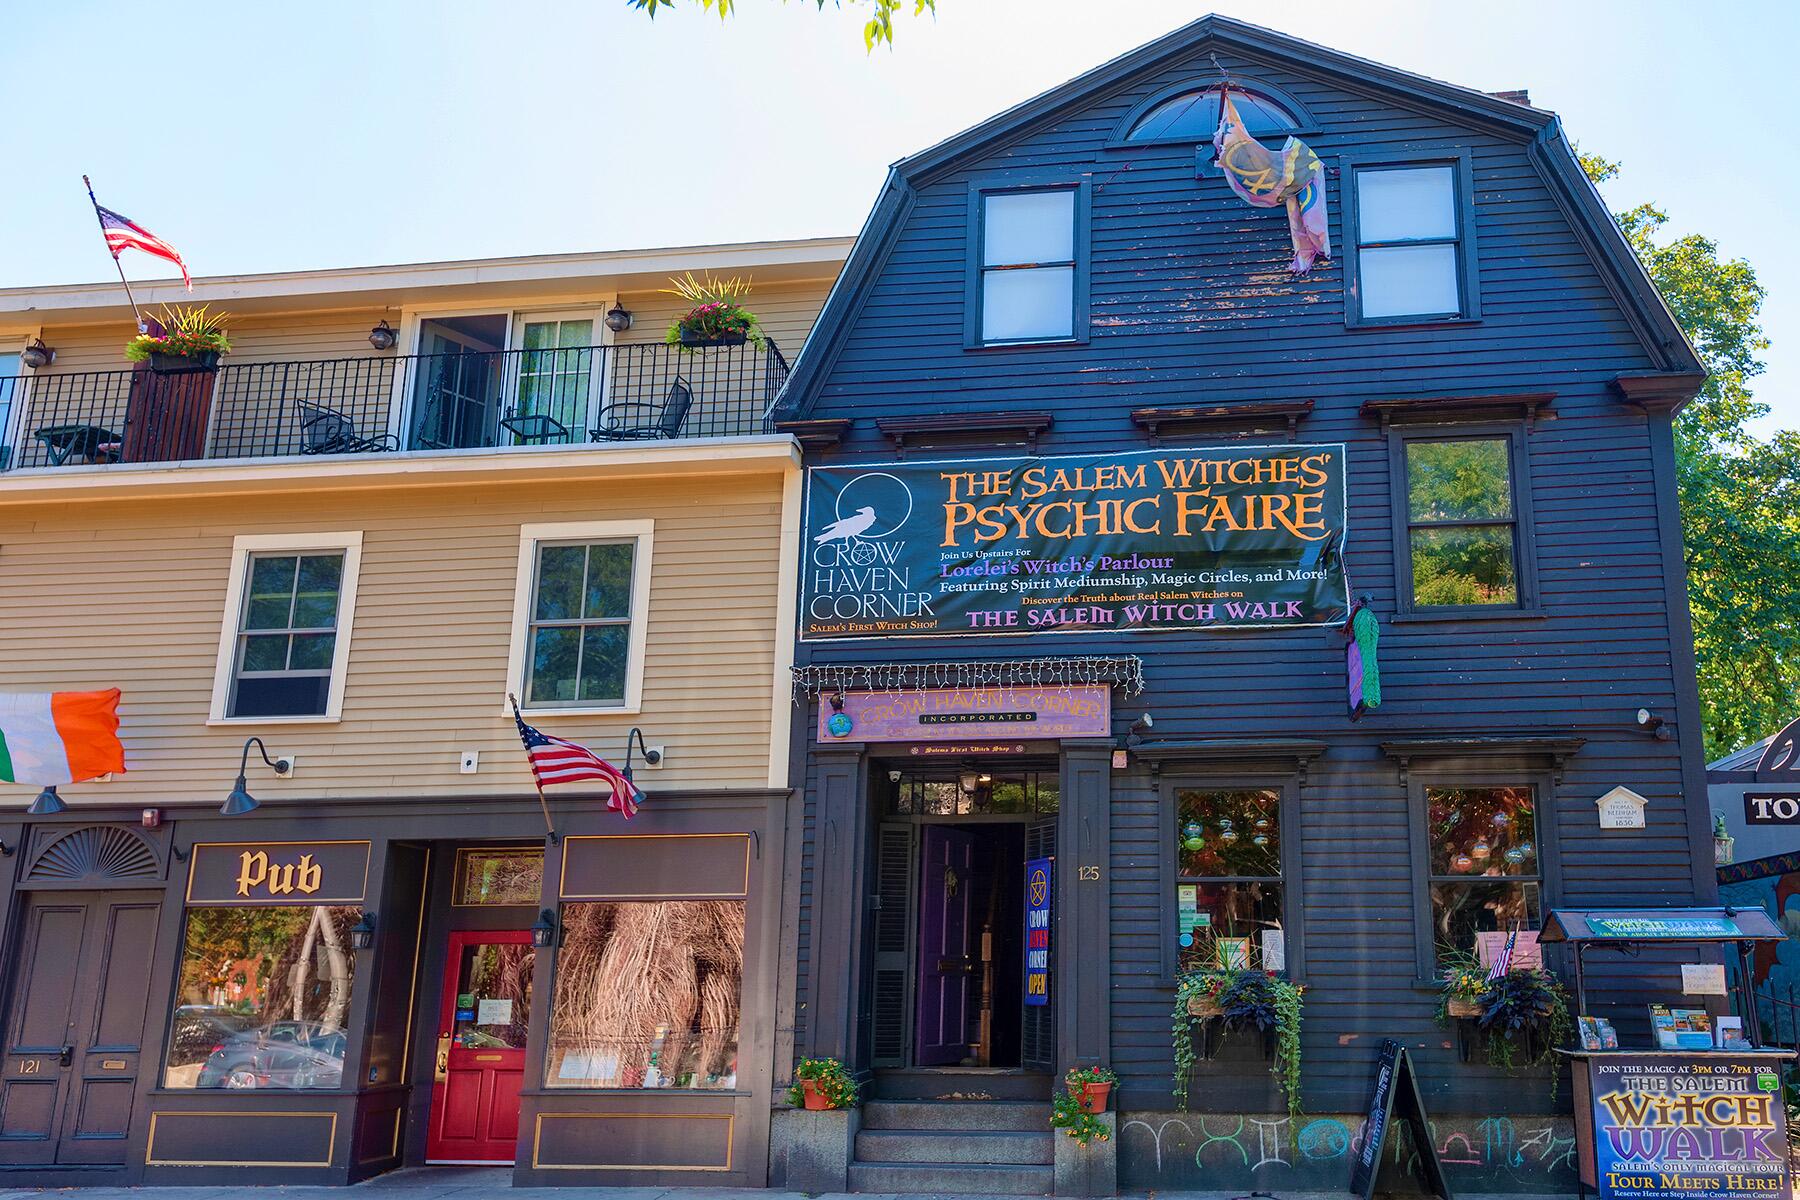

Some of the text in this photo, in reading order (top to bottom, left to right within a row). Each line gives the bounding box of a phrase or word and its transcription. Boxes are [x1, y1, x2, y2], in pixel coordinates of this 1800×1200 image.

[940, 469, 1012, 504] THE
[1021, 464, 1147, 501] SALEM
[939, 487, 1331, 548] PSYCHIC FAIRE
[813, 541, 905, 568] CROW
[940, 552, 1174, 578] Lorelei's Witch's Parlour
[941, 552, 959, 561] Join
[961, 551, 974, 559] Us
[975, 549, 1013, 560] Upstairs
[814, 567, 909, 593] HAVEN
[939, 568, 1328, 594] Featuring Spirit Mediumship, Magic Circles, and More!
[810, 592, 935, 620] CORNER
[1022, 597, 1062, 605] Discover
[1064, 595, 1078, 603] the
[1079, 593, 1107, 602] Truth
[1109, 592, 1136, 602] about
[1137, 591, 1158, 601] Real
[1160, 591, 1189, 600] Salem
[1190, 590, 1229, 599] Witches
[965, 610, 1019, 628] THE
[1223, 600, 1304, 619] WALK
[861, 690, 1101, 724] CROW HAVEN CORNER
[923, 714, 1032, 722] INCORPORATED
[1752, 798, 1800, 819] TO
[236, 850, 322, 897] Pub
[1078, 866, 1100, 881] 125
[1029, 909, 1049, 928] CROW
[1028, 973, 1047, 995] OPEN
[20, 1060, 40, 1073] 121
[1598, 1065, 1773, 1074] JOIN THE MAGIC AT 3PM OR 7PM FOR
[1623, 1077, 1667, 1091] THE
[1604, 1127, 1782, 1161] WALK
[1752, 1164, 1785, 1173] TOUR
[1670, 1191, 1685, 1199] Step
